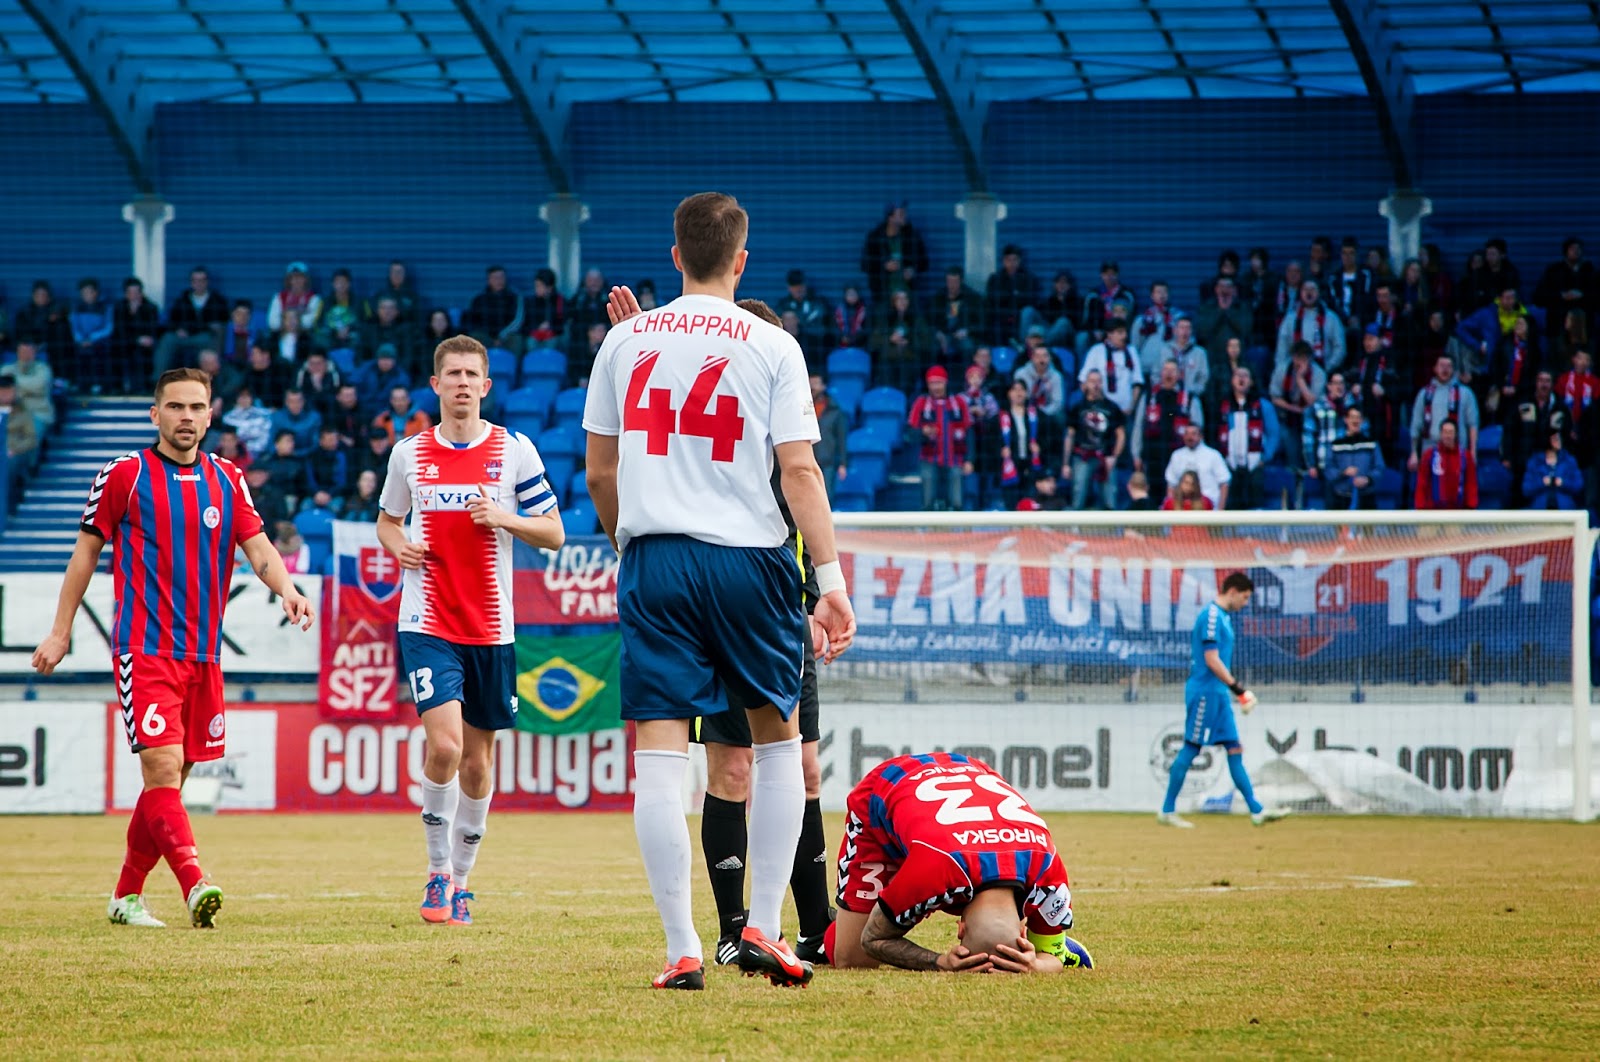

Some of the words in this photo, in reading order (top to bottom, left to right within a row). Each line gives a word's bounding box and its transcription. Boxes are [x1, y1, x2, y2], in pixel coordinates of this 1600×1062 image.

[632, 312, 752, 342] CHRAPPAN
[623, 350, 745, 463] 44
[852, 537, 1027, 626] EZNÁ
[1376, 553, 1548, 626] 1921
[333, 641, 395, 668] ANTI
[328, 667, 396, 712] SFZ
[409, 667, 434, 704] 13
[141, 702, 167, 737] 6
[914, 773, 1048, 830] 33
[952, 827, 1048, 848] PIROSKA
